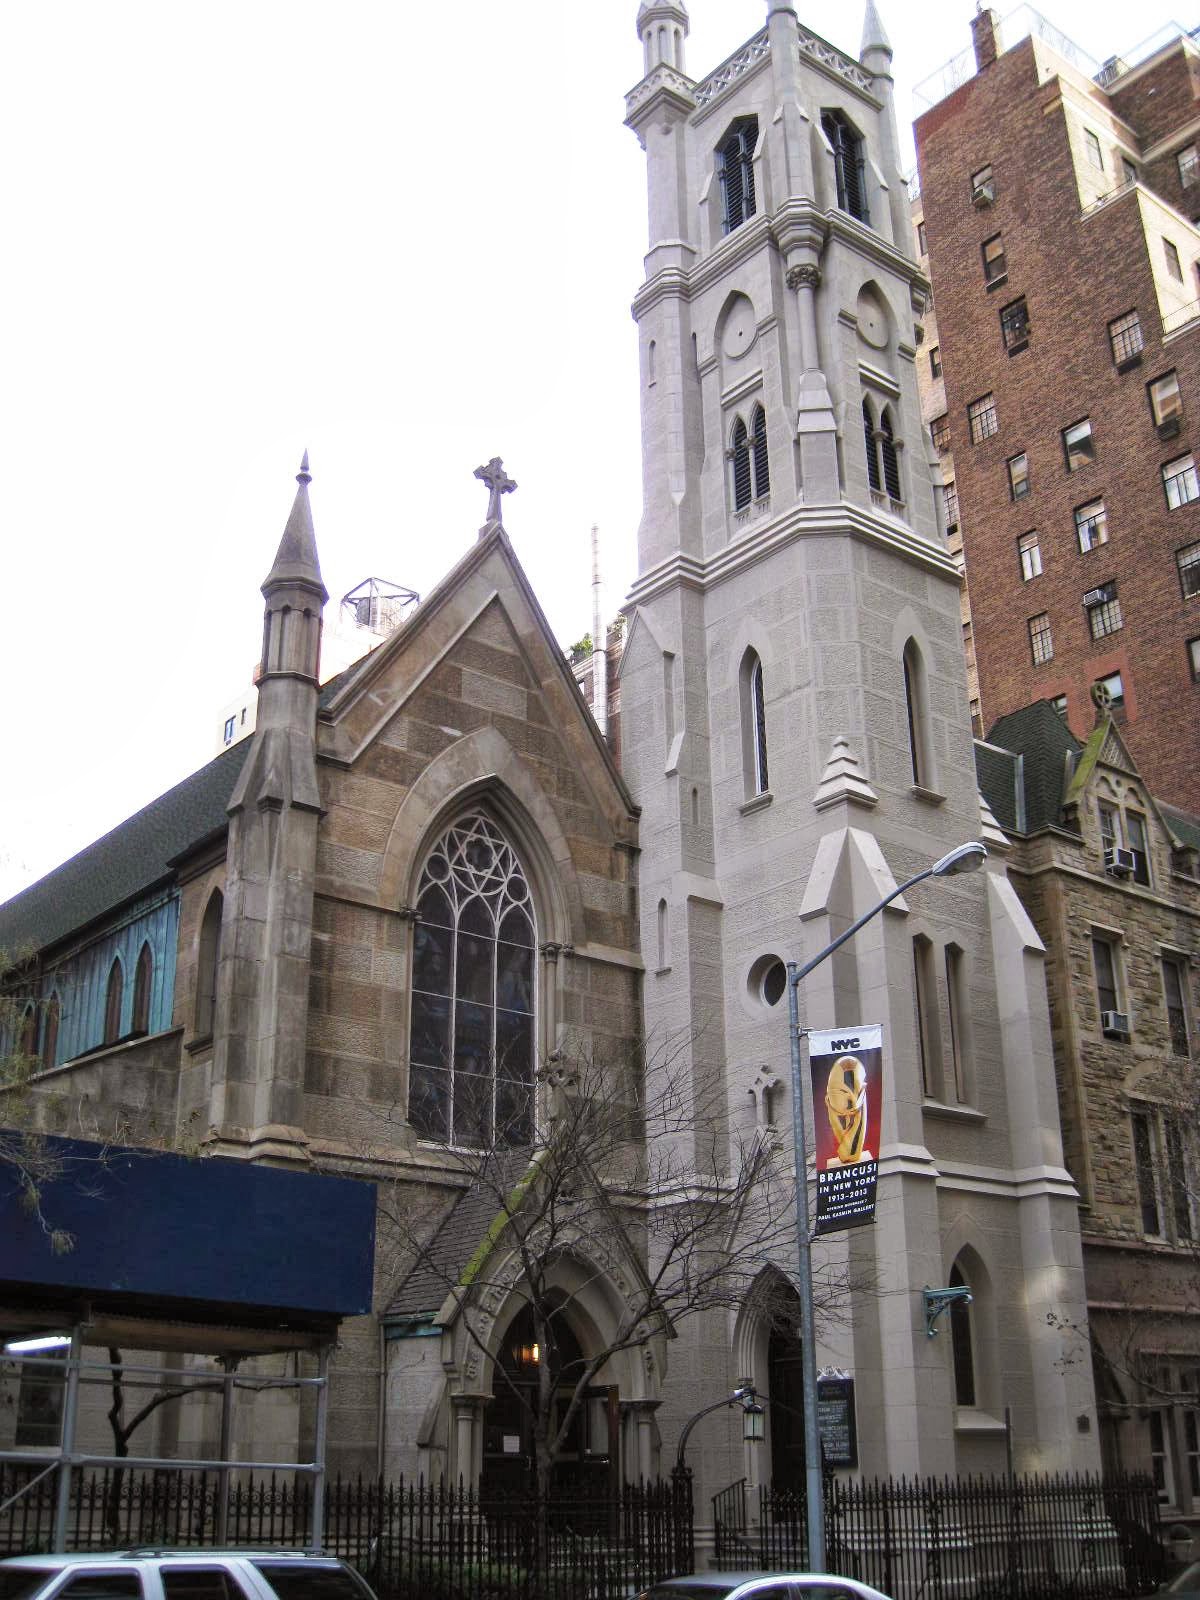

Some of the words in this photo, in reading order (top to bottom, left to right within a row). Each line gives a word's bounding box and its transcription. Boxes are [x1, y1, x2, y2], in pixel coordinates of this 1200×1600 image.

[831, 1037, 860, 1051] NYC
[819, 1162, 877, 1183] BRANCUSI
[820, 1186, 829, 1194] IN
[833, 1181, 852, 1191] NEW
[855, 1175, 876, 1187] YORK
[828, 1188, 867, 1203] 1913-2013
[853, 1204, 875, 1212] GALLERY
